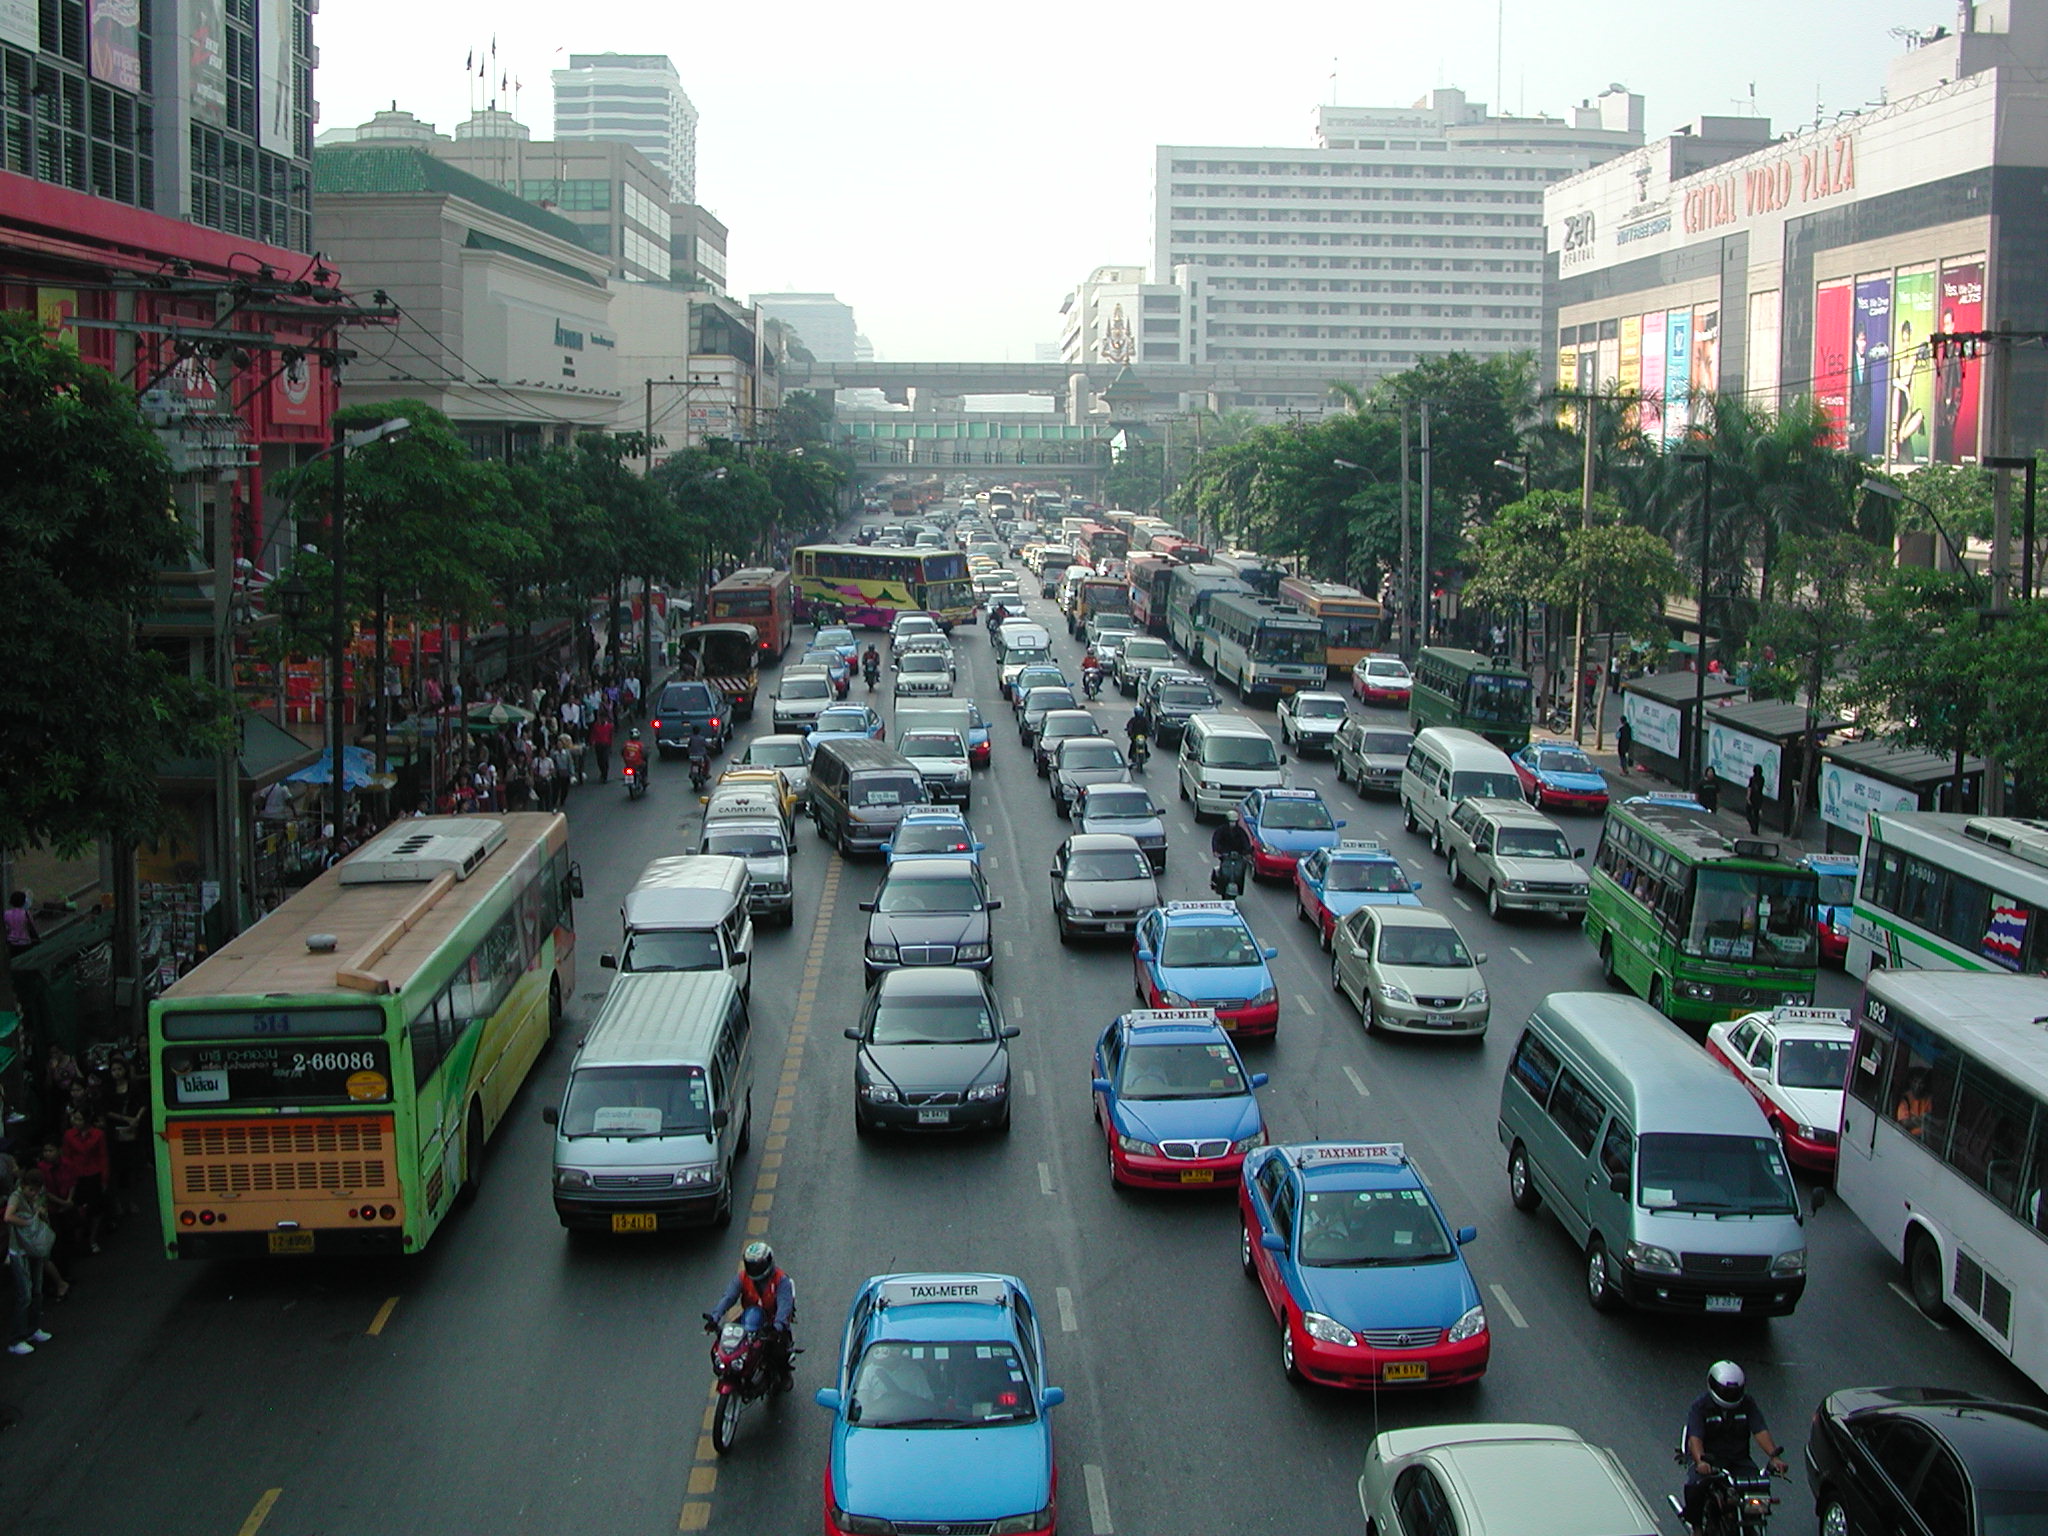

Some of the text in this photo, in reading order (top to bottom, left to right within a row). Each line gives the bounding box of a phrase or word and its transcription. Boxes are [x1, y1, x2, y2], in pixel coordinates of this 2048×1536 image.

[1682, 134, 1855, 235] CENTRAL WORLD PLAZA
[1561, 246, 1595, 271] CENTRAL
[1825, 804, 1840, 819] APEC
[1182, 902, 1222, 910] TAXI-METER
[1151, 1010, 1209, 1020] TAXI-METER
[1789, 1009, 1837, 1019] TAXI-METER
[1869, 1000, 1892, 1024] 193
[292, 1051, 375, 1072] 2-66086
[1318, 1146, 1388, 1159] TAXI-METER
[910, 1284, 978, 1297] TAXI-METER
